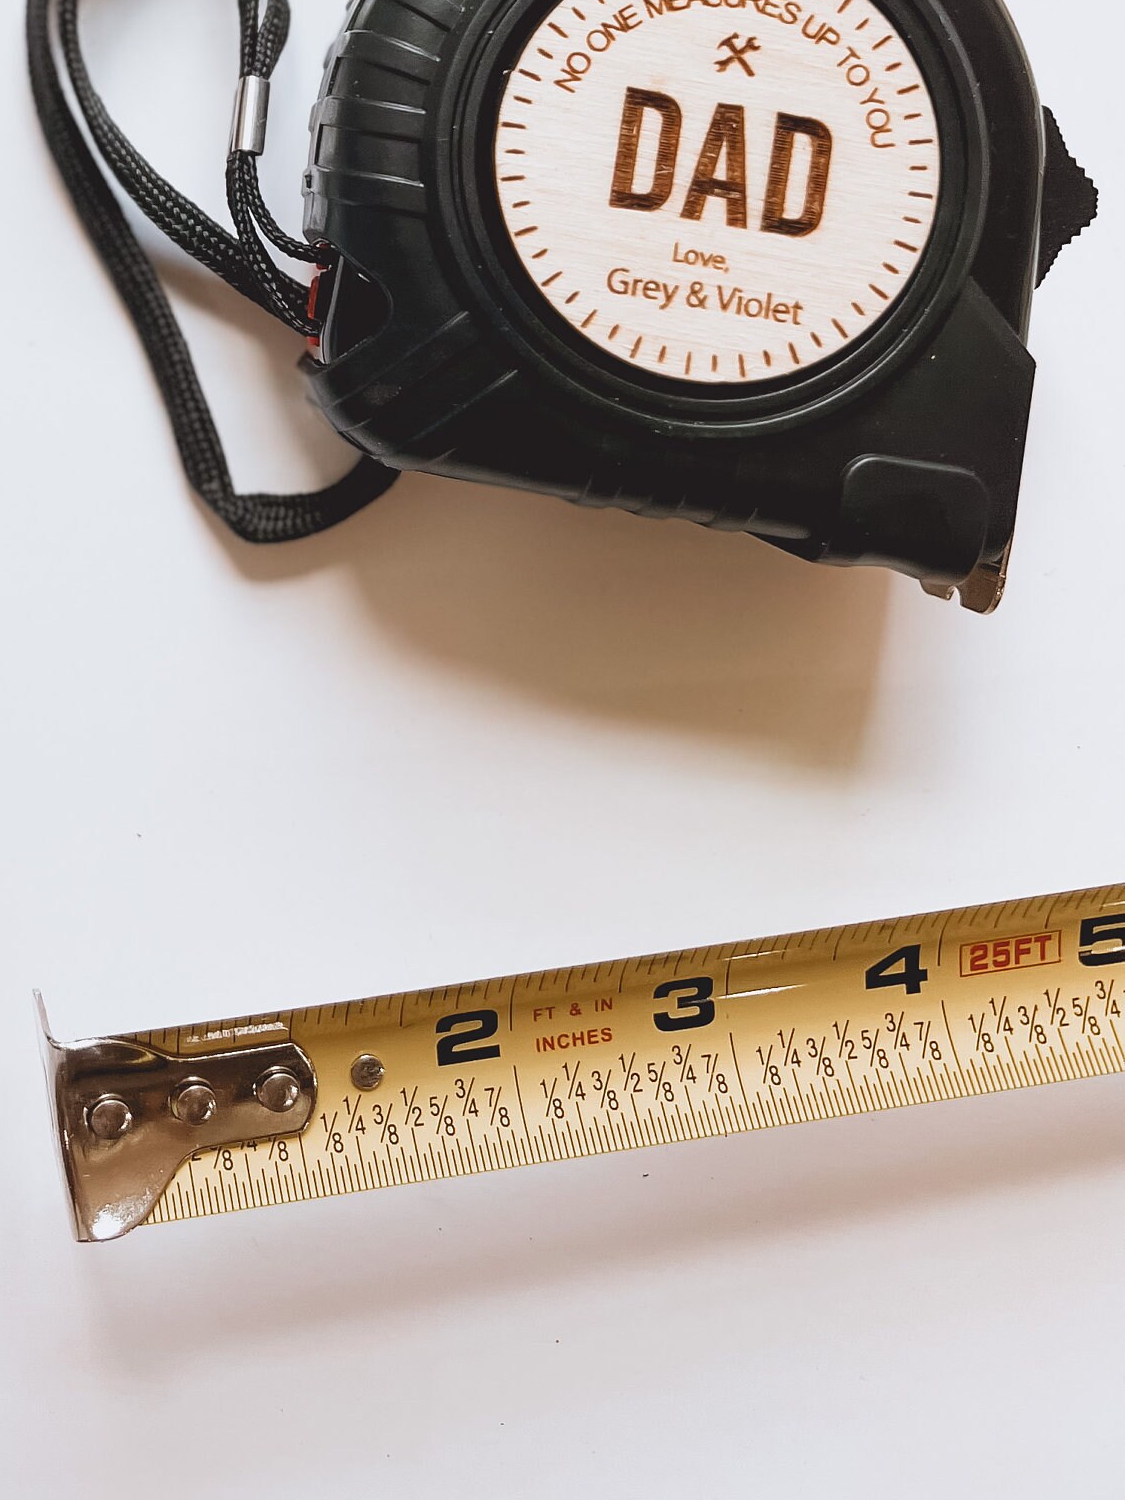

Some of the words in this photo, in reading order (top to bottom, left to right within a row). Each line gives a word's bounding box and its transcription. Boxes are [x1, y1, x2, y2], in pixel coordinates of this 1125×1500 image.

[554, 52, 592, 93] NO
[586, 5, 644, 54] ONE
[800, 15, 841, 47] UP
[835, 46, 871, 87] TO
[860, 87, 896, 148] YOU
[609, 86, 833, 238] DAD
[606, 267, 680, 311] Grey
[685, 280, 708, 309] &
[716, 284, 803, 325] Violet
[969, 935, 1052, 972] 25FT
[1078, 913, 1125, 967] 5
[865, 944, 928, 995] 4
[533, 1006, 556, 1022] FT
[569, 1002, 582, 1017] &
[595, 998, 613, 1012] IN
[653, 976, 715, 1032] 3
[435, 1009, 501, 1066] 2
[536, 1027, 613, 1053] INCHES
